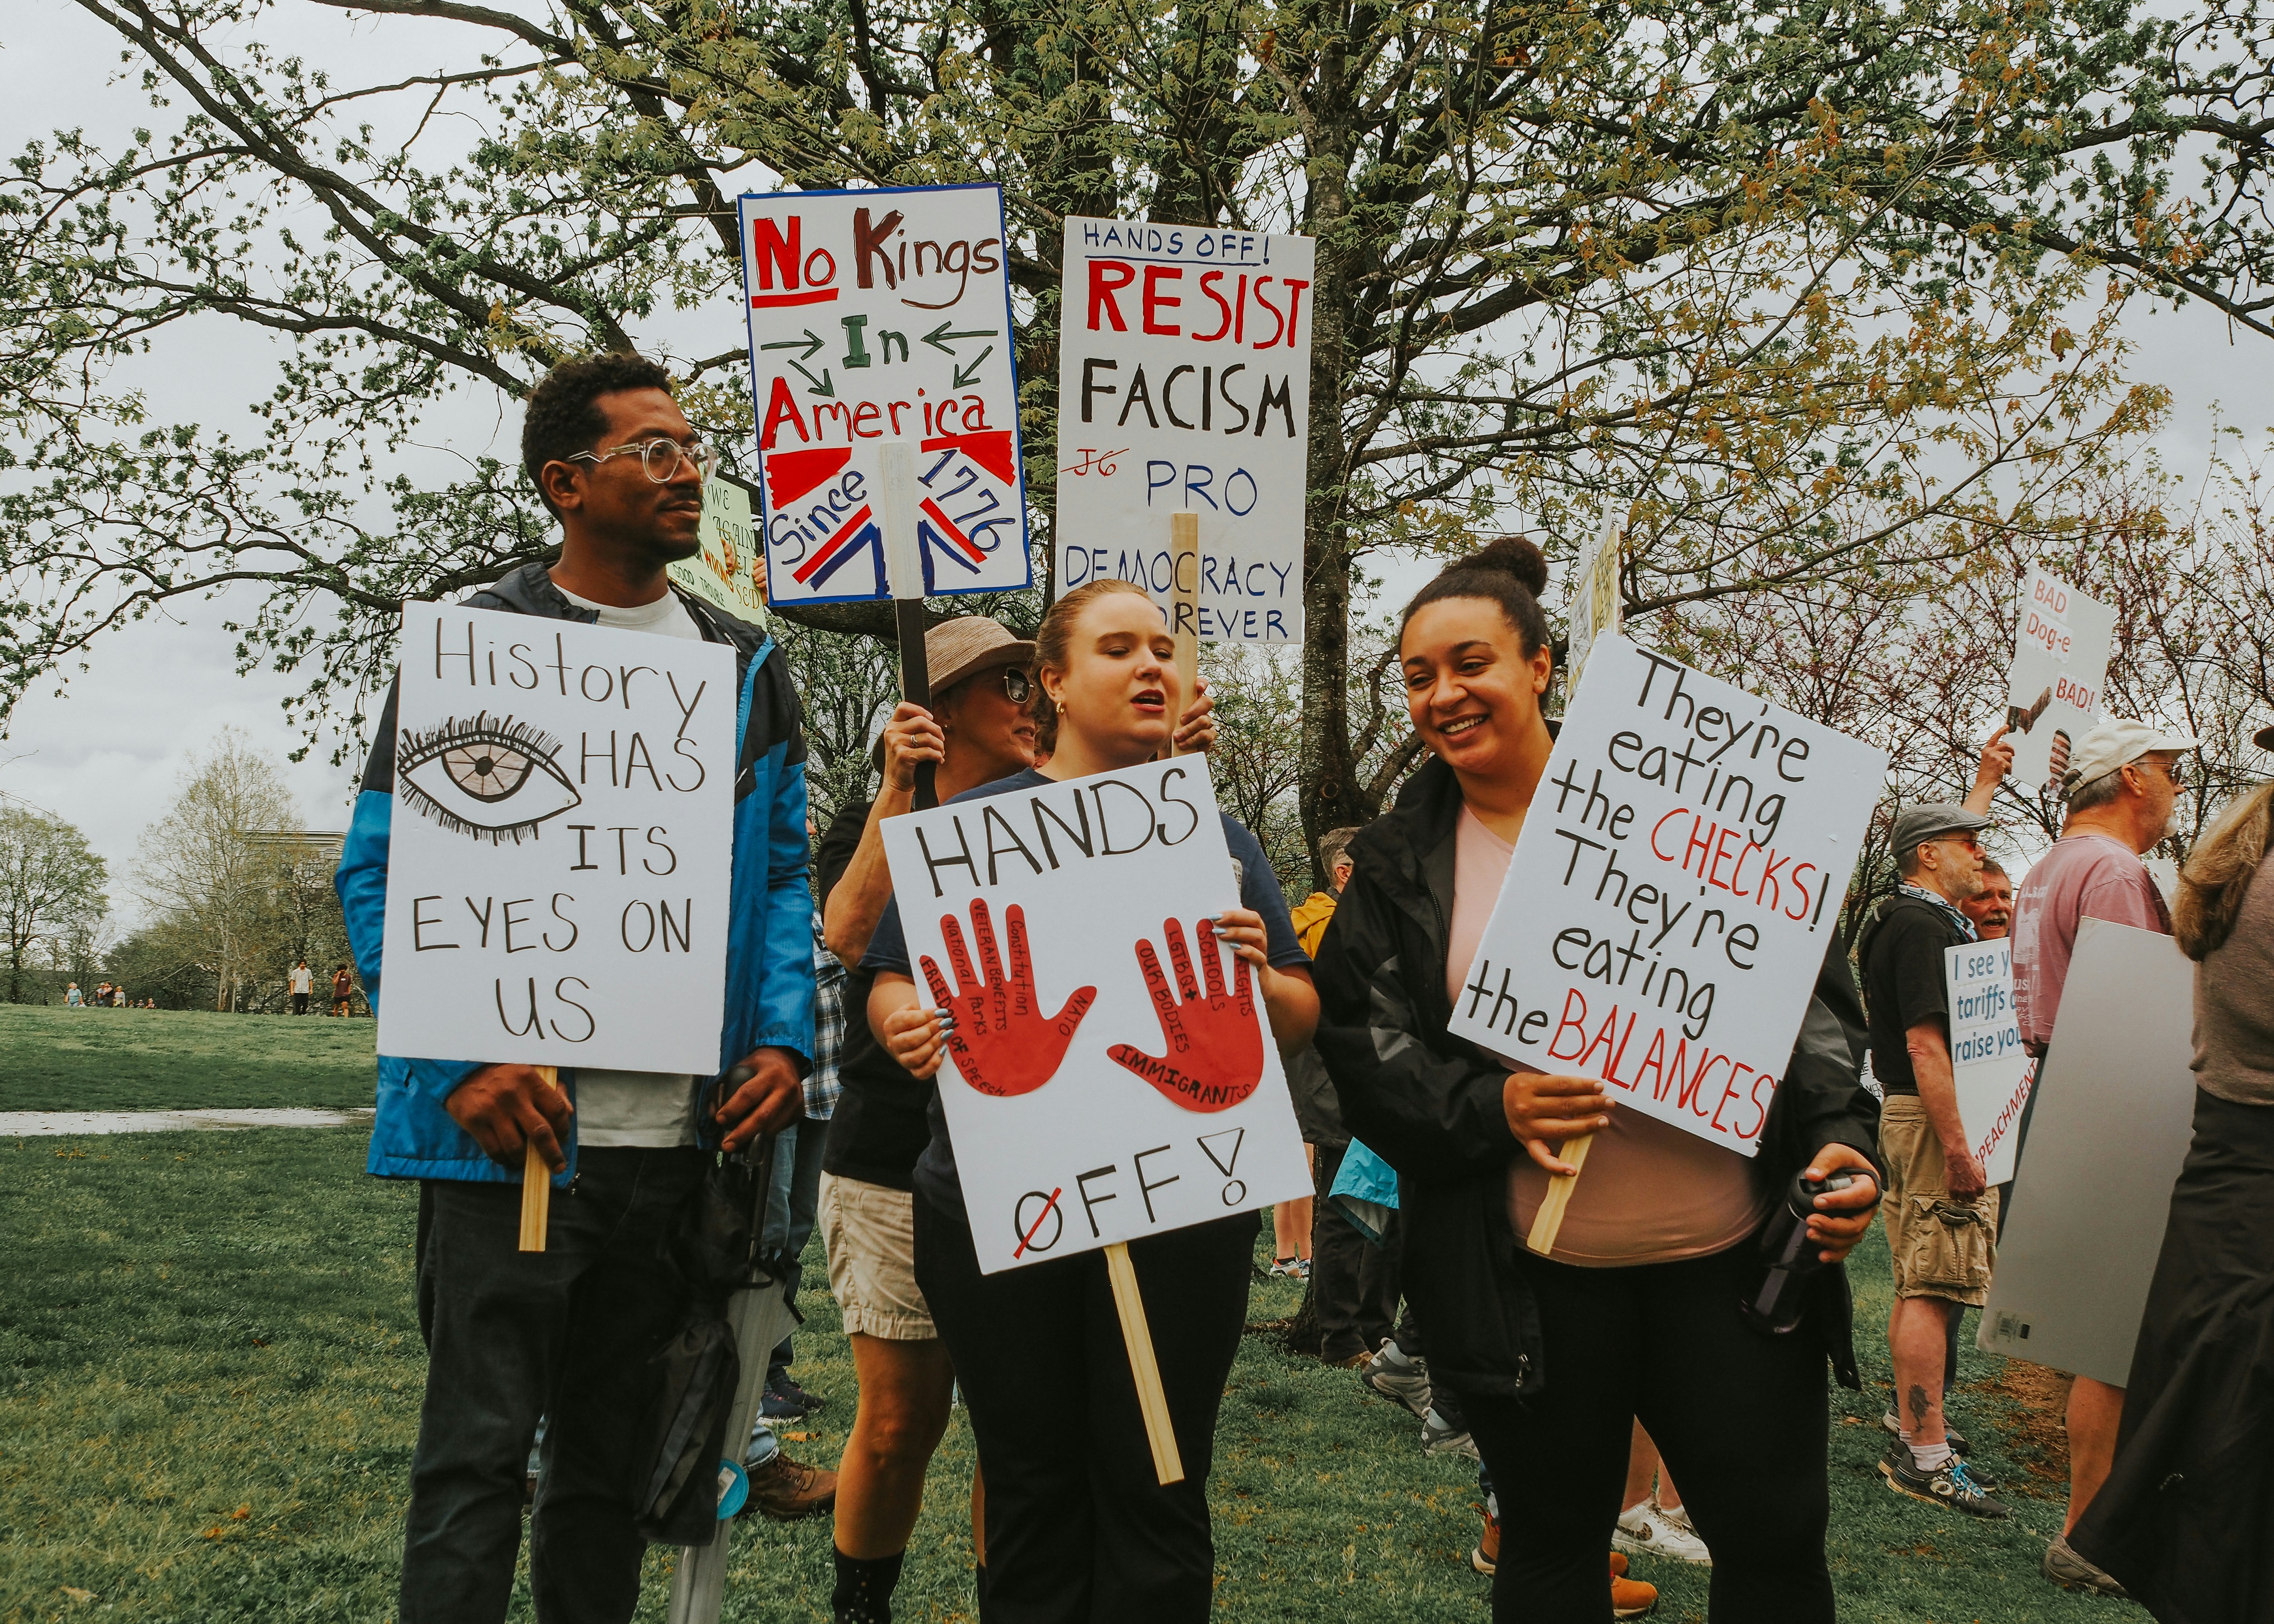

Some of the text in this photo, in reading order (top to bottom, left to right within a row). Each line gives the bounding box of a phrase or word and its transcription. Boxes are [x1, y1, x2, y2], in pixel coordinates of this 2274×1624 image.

[753, 207, 1000, 309] No Kings
[1084, 223, 1270, 265] HANDS OFF!
[841, 314, 910, 369] In
[1087, 260, 1310, 350] RESIST
[760, 376, 993, 451] America
[1081, 358, 1297, 438] FACISM
[768, 471, 868, 565] Since
[917, 449, 1016, 552] 1776
[1147, 460, 1258, 517] PRO
[1066, 546, 1292, 598] DEMOCRACY
[2034, 579, 2067, 614] BAD
[1157, 602, 1288, 640] REVER
[436, 617, 706, 738] History
[2056, 677, 2095, 713] BAD!
[1636, 648, 1810, 783] They're
[580, 729, 706, 793] HAS
[1608, 730, 1786, 846] eating
[567, 824, 677, 877] ITS
[915, 768, 1198, 898] HANDS
[1551, 758, 1830, 932] the CHECKS!
[414, 893, 692, 953] EYES ON
[1555, 828, 1760, 970] They're
[947, 920, 977, 985] National
[973, 903, 1007, 1031] VETERAN BENEFITS
[1011, 920, 1032, 1016] Constitution
[1198, 930, 1225, 1012] SCHOOLS
[1552, 927, 1716, 1041] eating
[1968, 955, 1993, 978] see
[496, 976, 595, 1043] US
[1058, 994, 1089, 1036] NATO
[1139, 947, 1190, 1054] OUR BODIES
[1467, 960, 1548, 1045] the
[1957, 983, 2005, 1021] tariffs
[1115, 1046, 1251, 1104] IMMIGRANTS
[1955, 1032, 1993, 1063] raise
